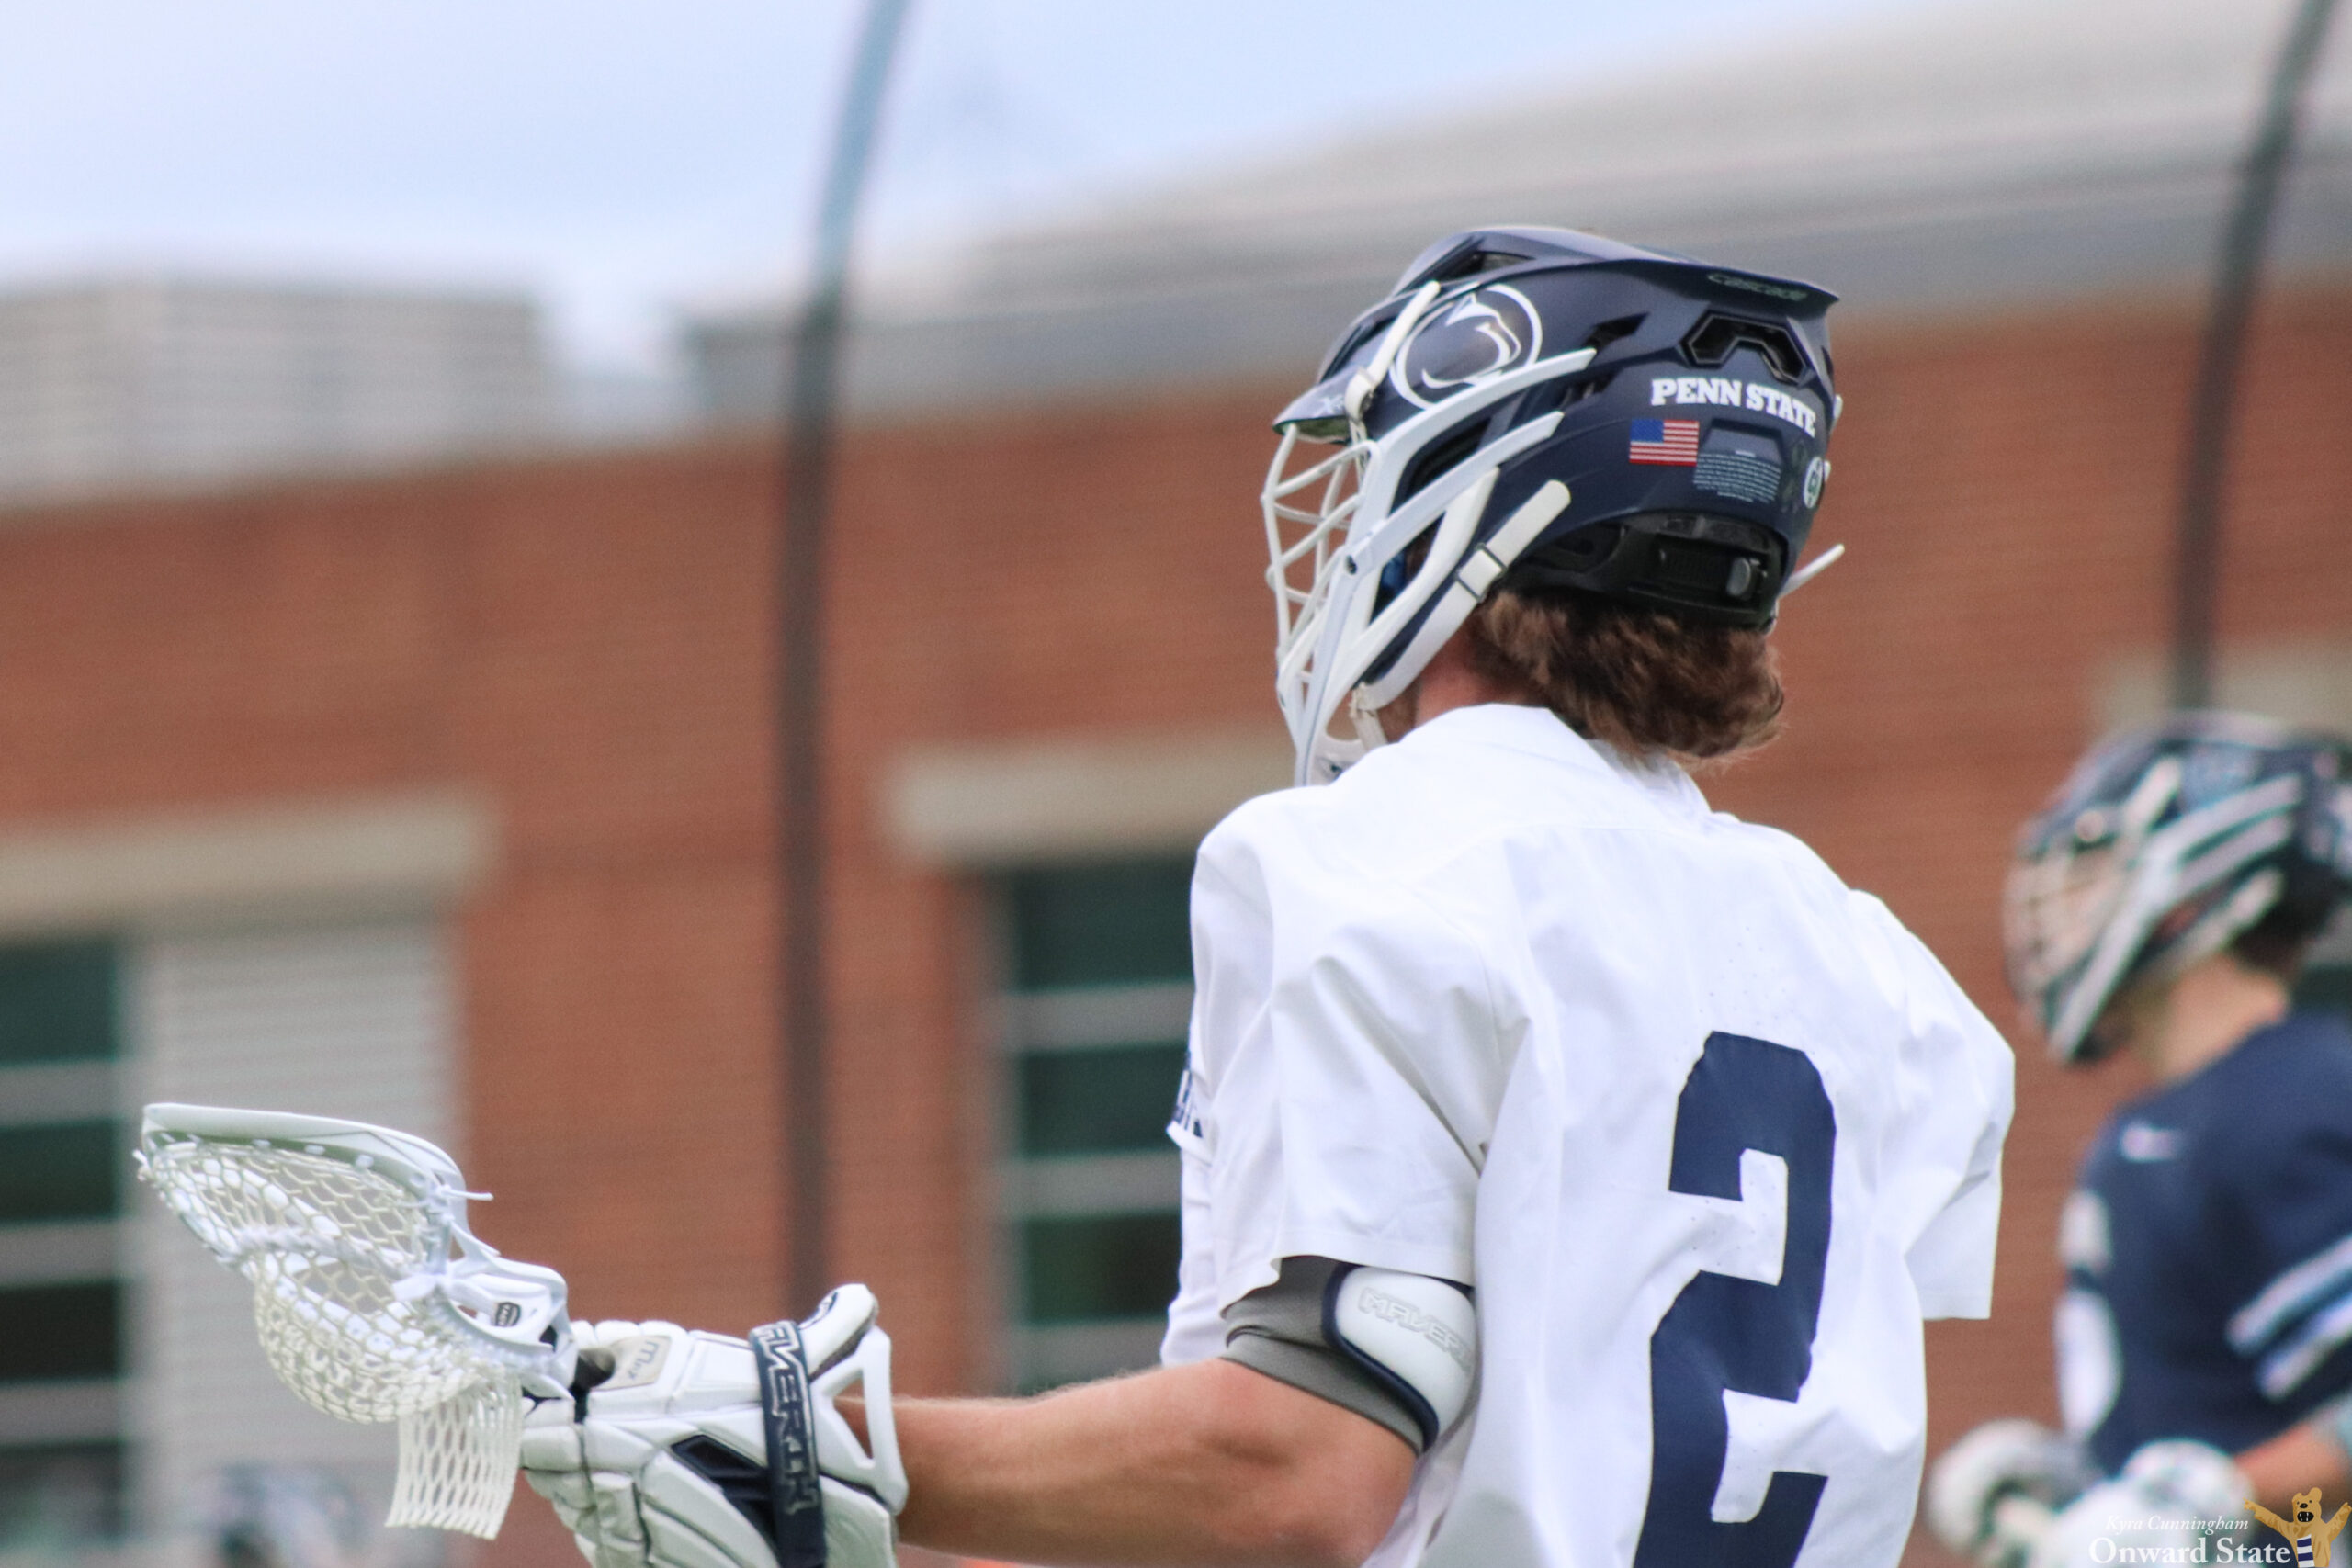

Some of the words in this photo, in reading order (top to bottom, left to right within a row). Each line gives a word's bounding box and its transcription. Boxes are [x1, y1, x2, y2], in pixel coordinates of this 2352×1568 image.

[1651, 376, 1742, 405] PENN
[1746, 383, 1816, 438] STATE
[1357, 1286, 1473, 1372] MAVER
[1633, 1030, 1837, 1568] 2
